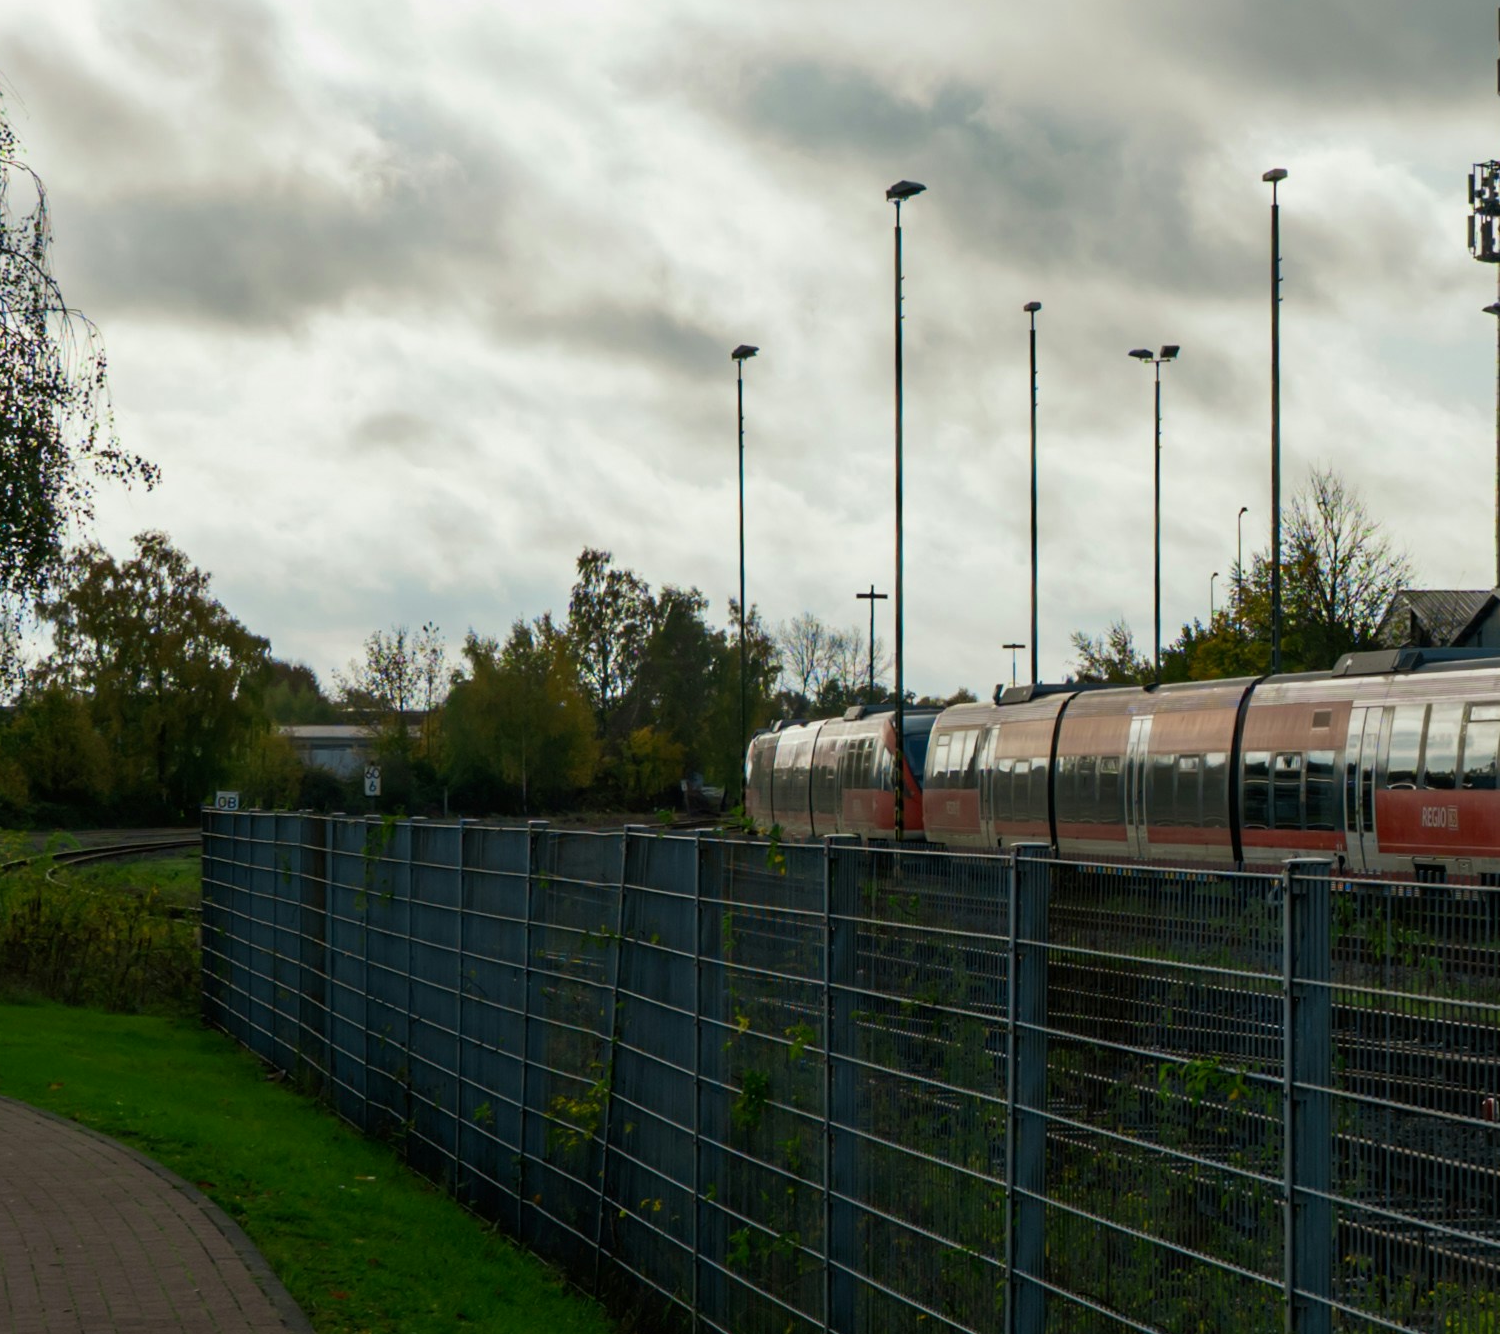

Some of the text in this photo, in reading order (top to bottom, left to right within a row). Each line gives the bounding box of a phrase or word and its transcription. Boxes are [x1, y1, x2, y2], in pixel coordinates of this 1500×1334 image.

[365, 767, 380, 779] 60
[369, 780, 376, 792] 6
[1422, 806, 1447, 828] REGIO
